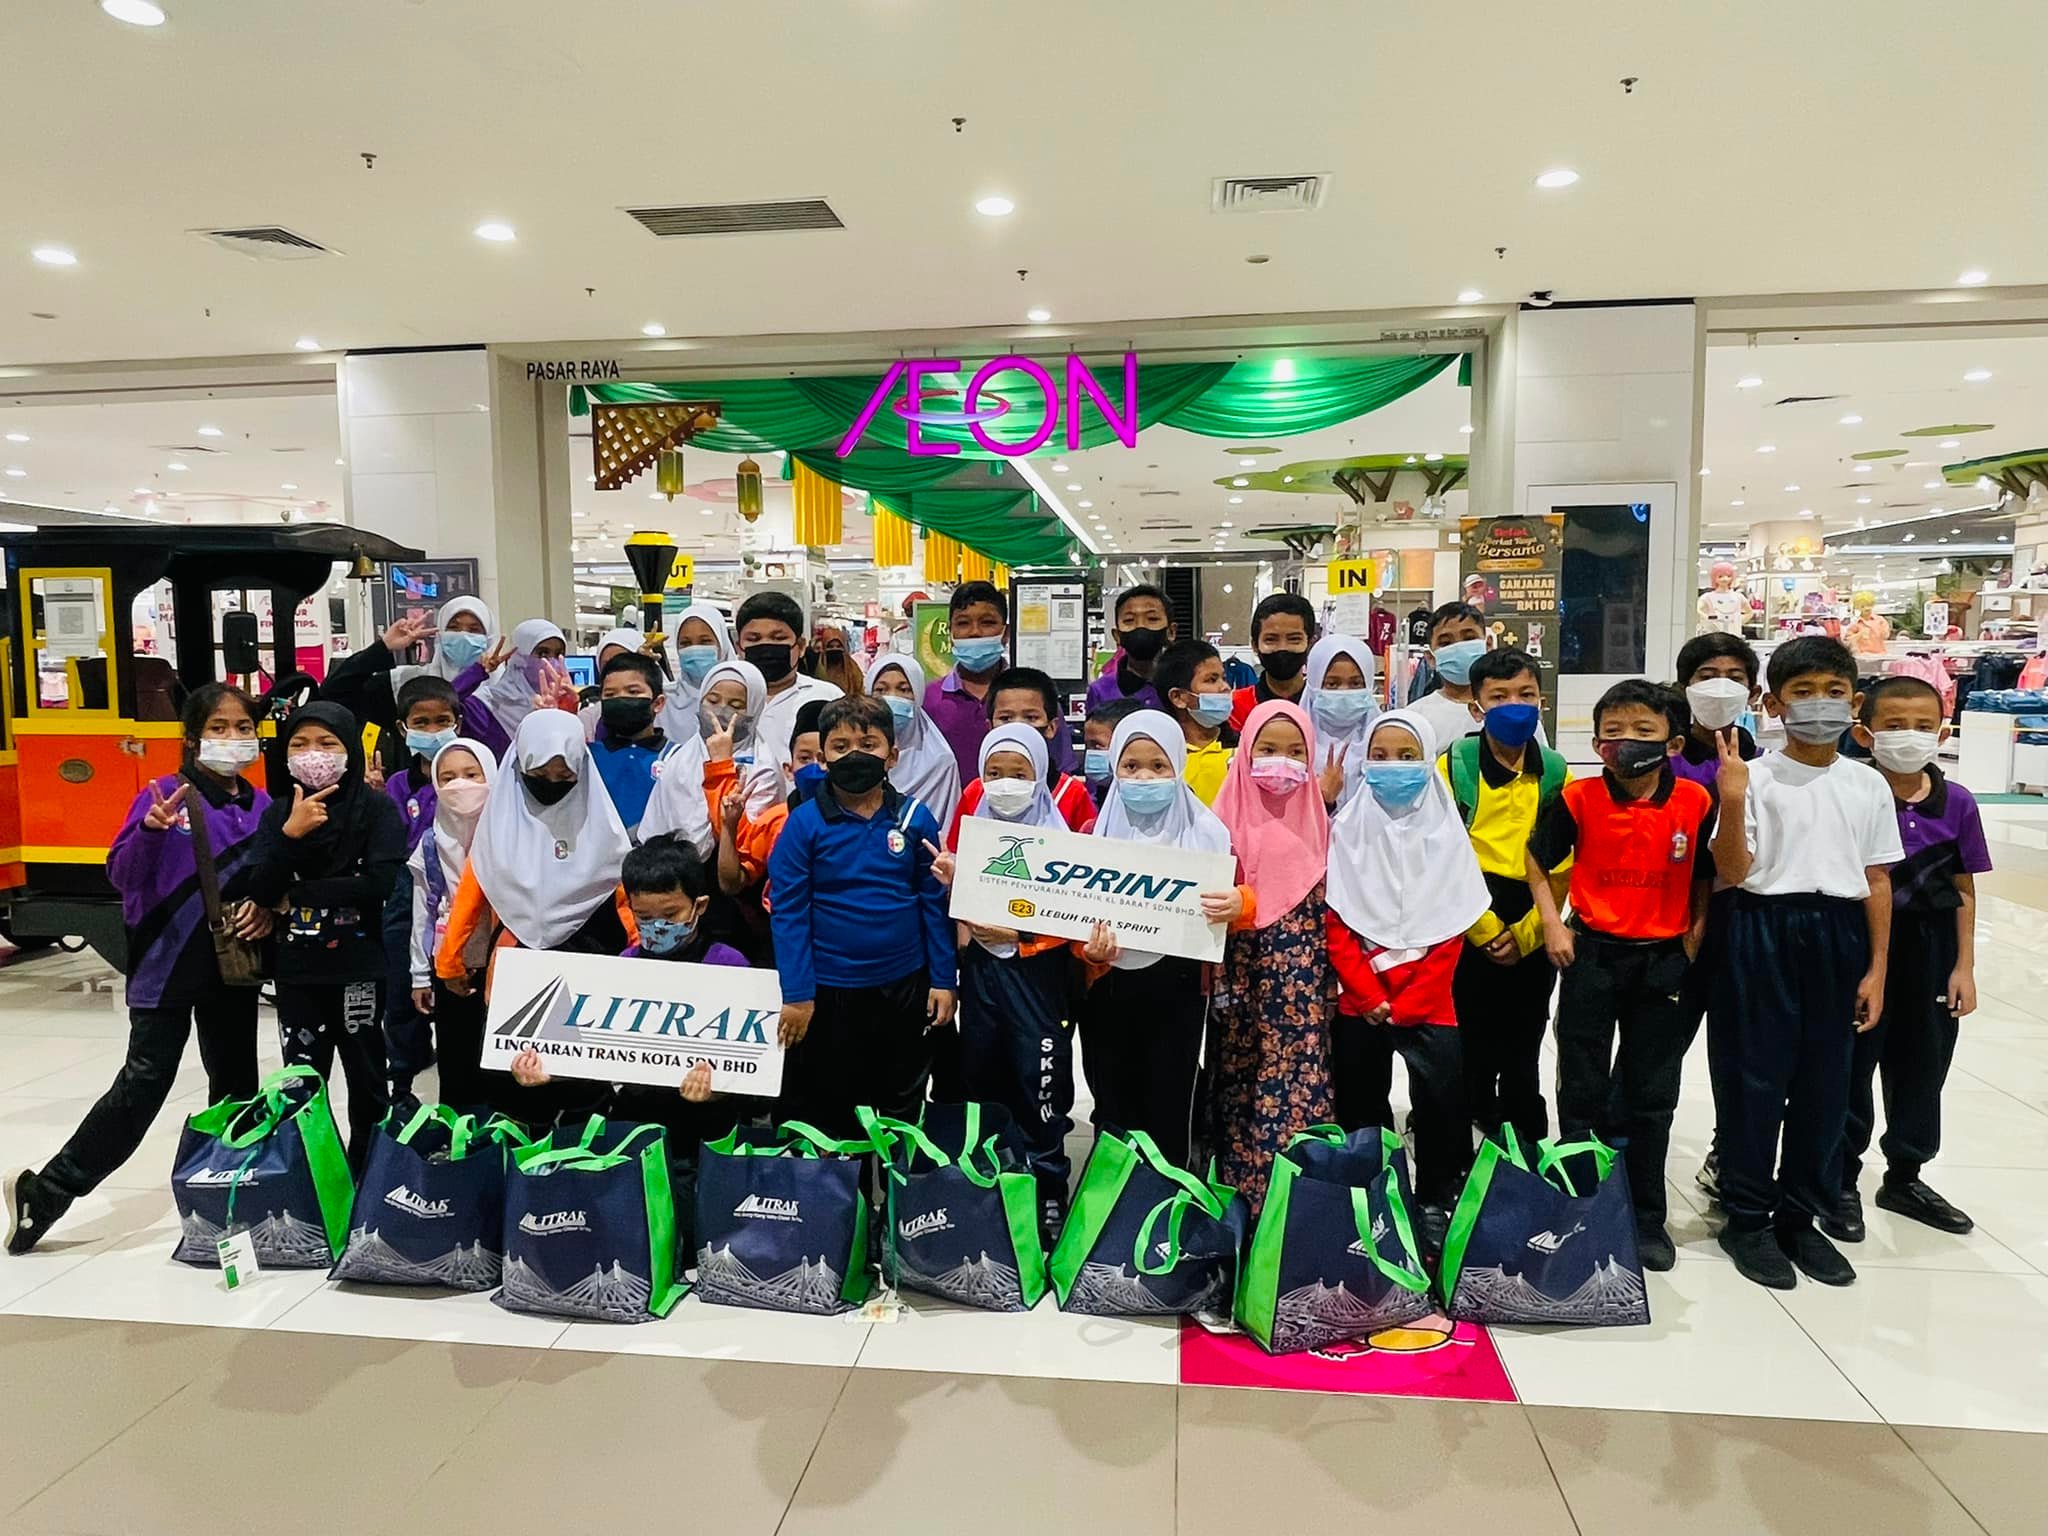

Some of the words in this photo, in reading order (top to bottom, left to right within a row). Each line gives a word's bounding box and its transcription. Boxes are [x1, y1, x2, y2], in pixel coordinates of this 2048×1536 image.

[526, 361, 577, 380] PASAR
[581, 360, 620, 379] RAYA
[1477, 543, 1546, 558] Bersama
[671, 565, 688, 577] UT
[1339, 568, 1367, 588] IN
[1499, 579, 1556, 589] GANJARAN
[1499, 590, 1526, 599] WANG
[1527, 590, 1556, 599] TUNAI
[1517, 600, 1555, 611] RM100
[1035, 861, 1198, 902] SPRINT
[979, 875, 1008, 886] SISTEM
[1010, 880, 1069, 896] PENYURAIAN
[1072, 889, 1102, 901] TRAFIK
[1106, 895, 1116, 904] KL
[1119, 897, 1150, 910] BARAT
[1152, 902, 1172, 913] SDN
[1175, 907, 1196, 917] BHD
[1012, 902, 1033, 915] E23
[1040, 908, 1079, 922] LEBUH
[1116, 920, 1161, 935] SPRINT
[563, 992, 781, 1045] LITRAK
[587, 1047, 637, 1064] TRANS
[641, 1052, 681, 1068] KOTA
[723, 1059, 757, 1074] BHD
[754, 1197, 799, 1215] LITRAK
[532, 1210, 587, 1230] LITRAK
